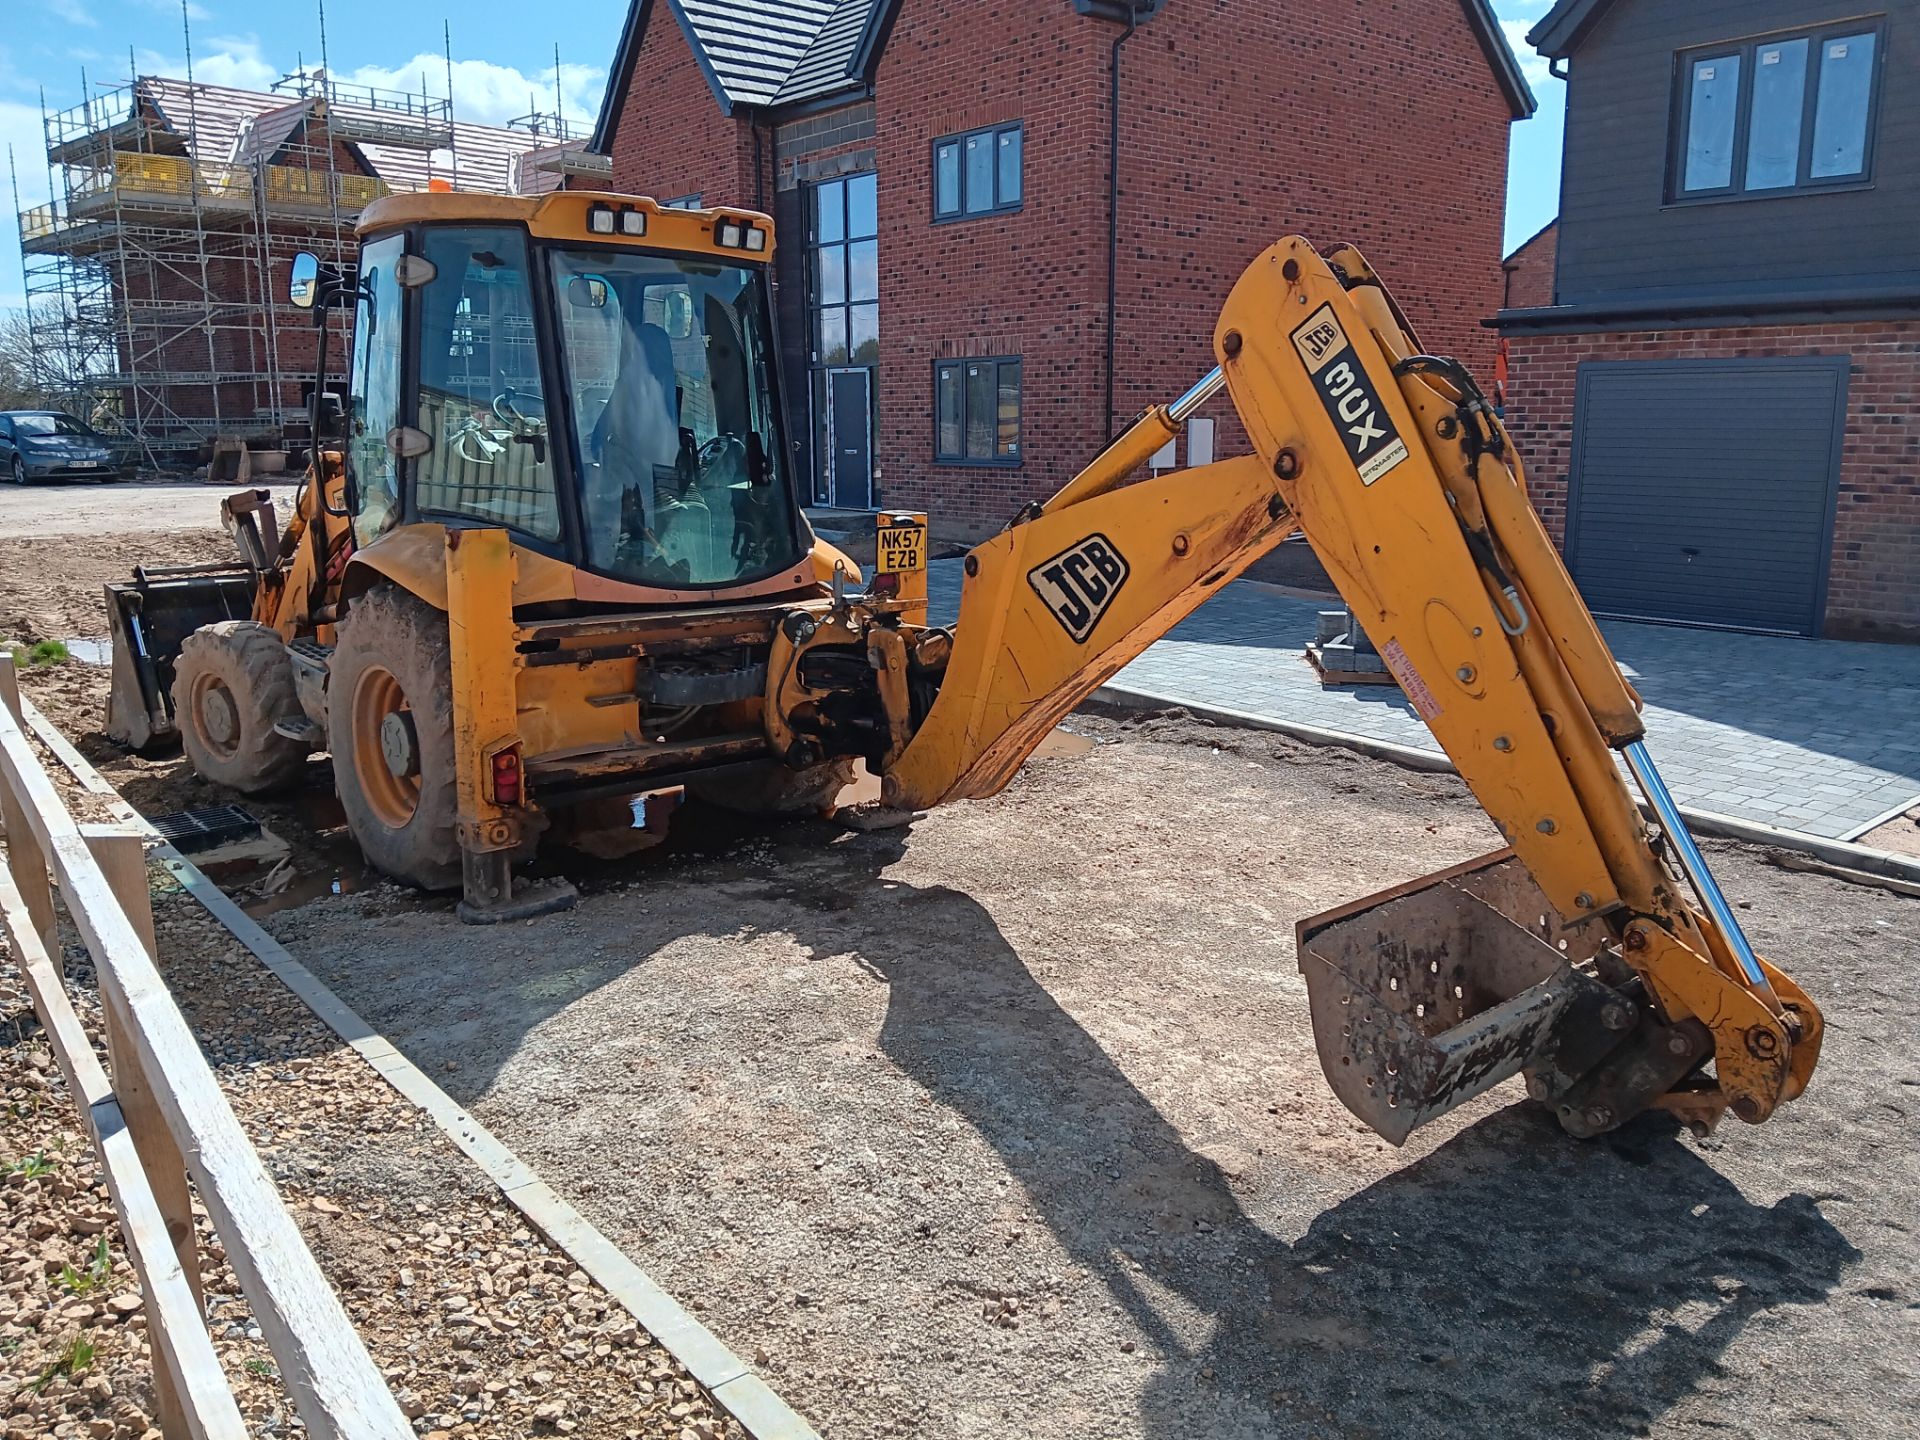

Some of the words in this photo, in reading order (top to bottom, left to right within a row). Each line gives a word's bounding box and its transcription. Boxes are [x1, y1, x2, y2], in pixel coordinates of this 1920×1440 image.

[1305, 324, 1335, 356] JCB
[1325, 362, 1387, 454] 3CX
[1362, 445, 1403, 478] SITEMASTER
[882, 530, 921, 549] NK57
[887, 550, 916, 568] EZB
[1042, 542, 1120, 631] JCB
